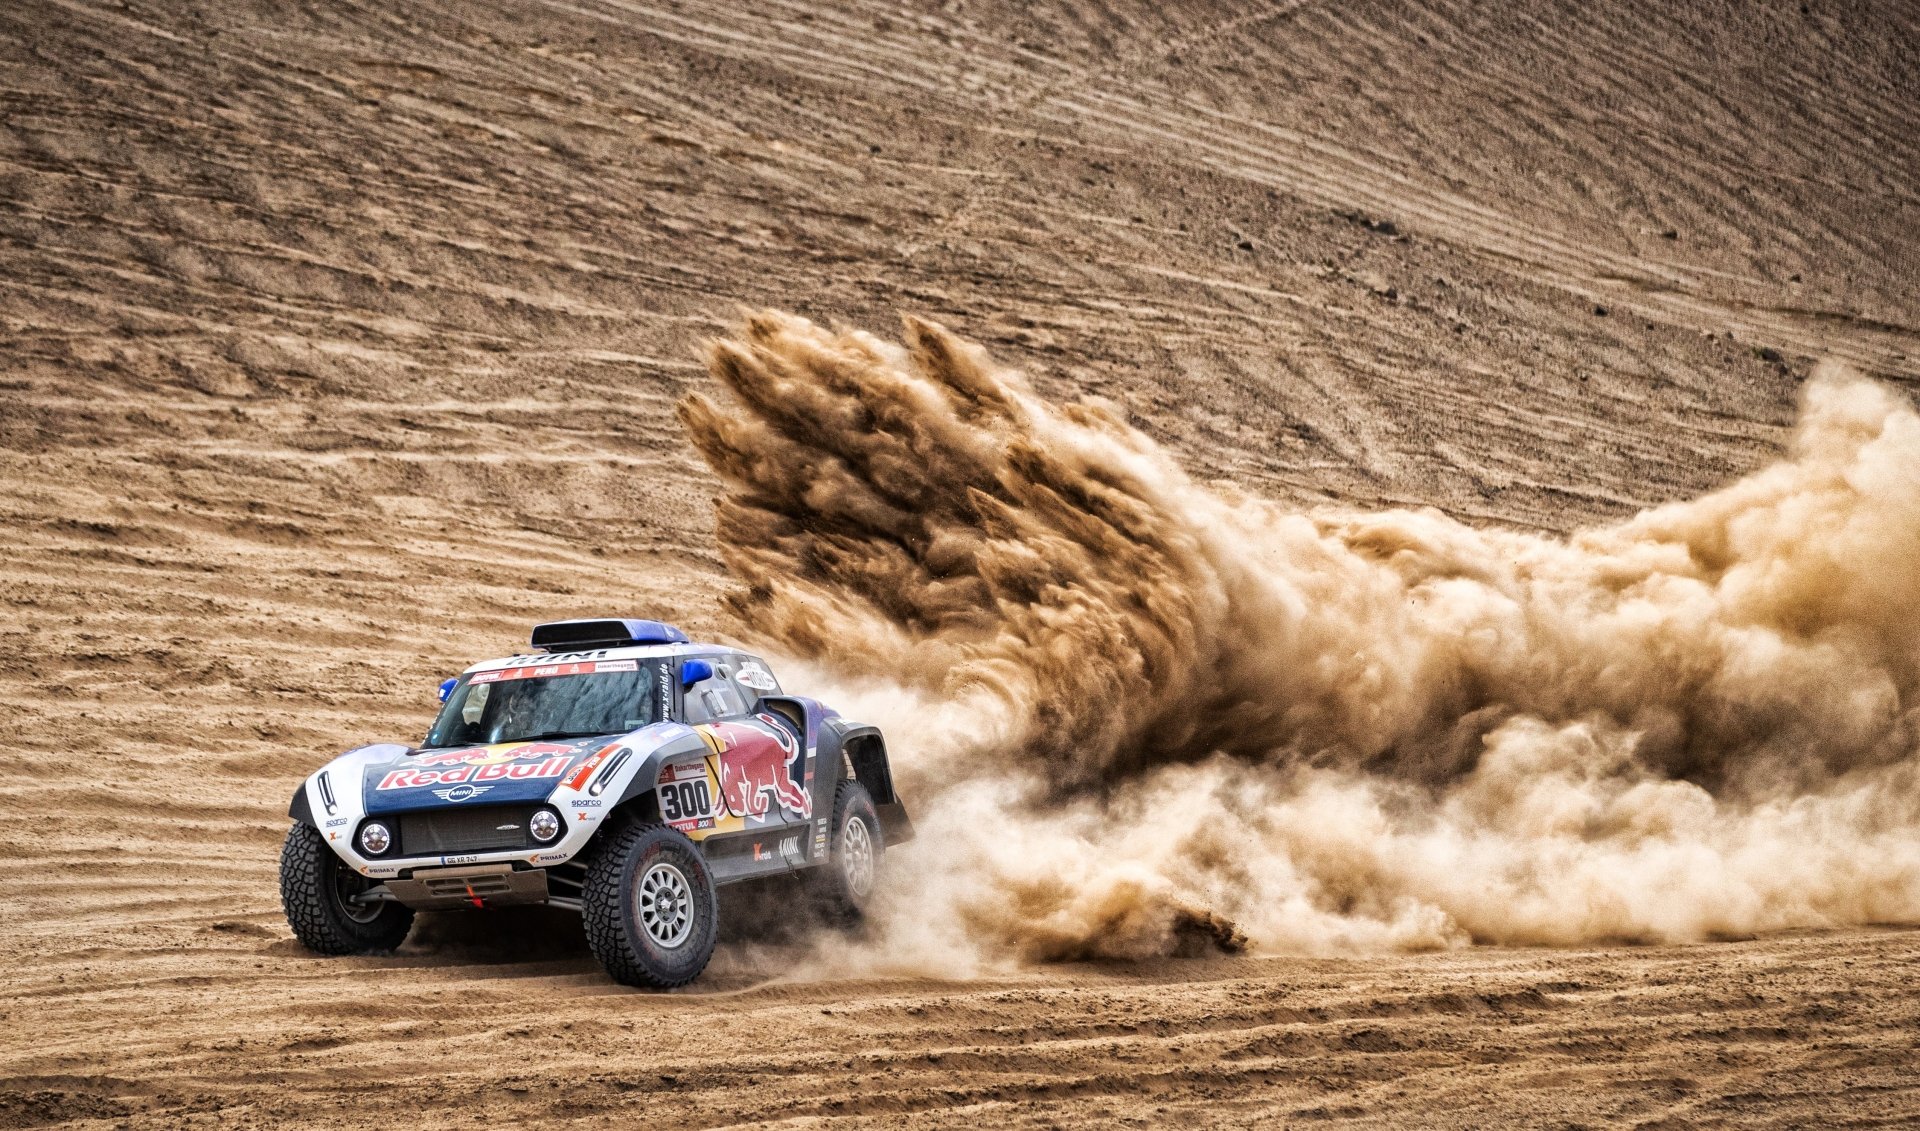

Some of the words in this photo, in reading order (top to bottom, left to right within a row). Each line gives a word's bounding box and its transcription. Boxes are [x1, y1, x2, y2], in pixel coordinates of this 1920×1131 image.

[376, 765, 478, 791] Red
[471, 755, 576, 782] Bull
[450, 789, 472, 797] MINI
[571, 799, 602, 807] sparco
[661, 780, 711, 820] 300
[325, 818, 348, 827] sparco
[672, 821, 696, 832] OTUL
[778, 835, 799, 857] MINI
[540, 853, 568, 861] PRIMAX
